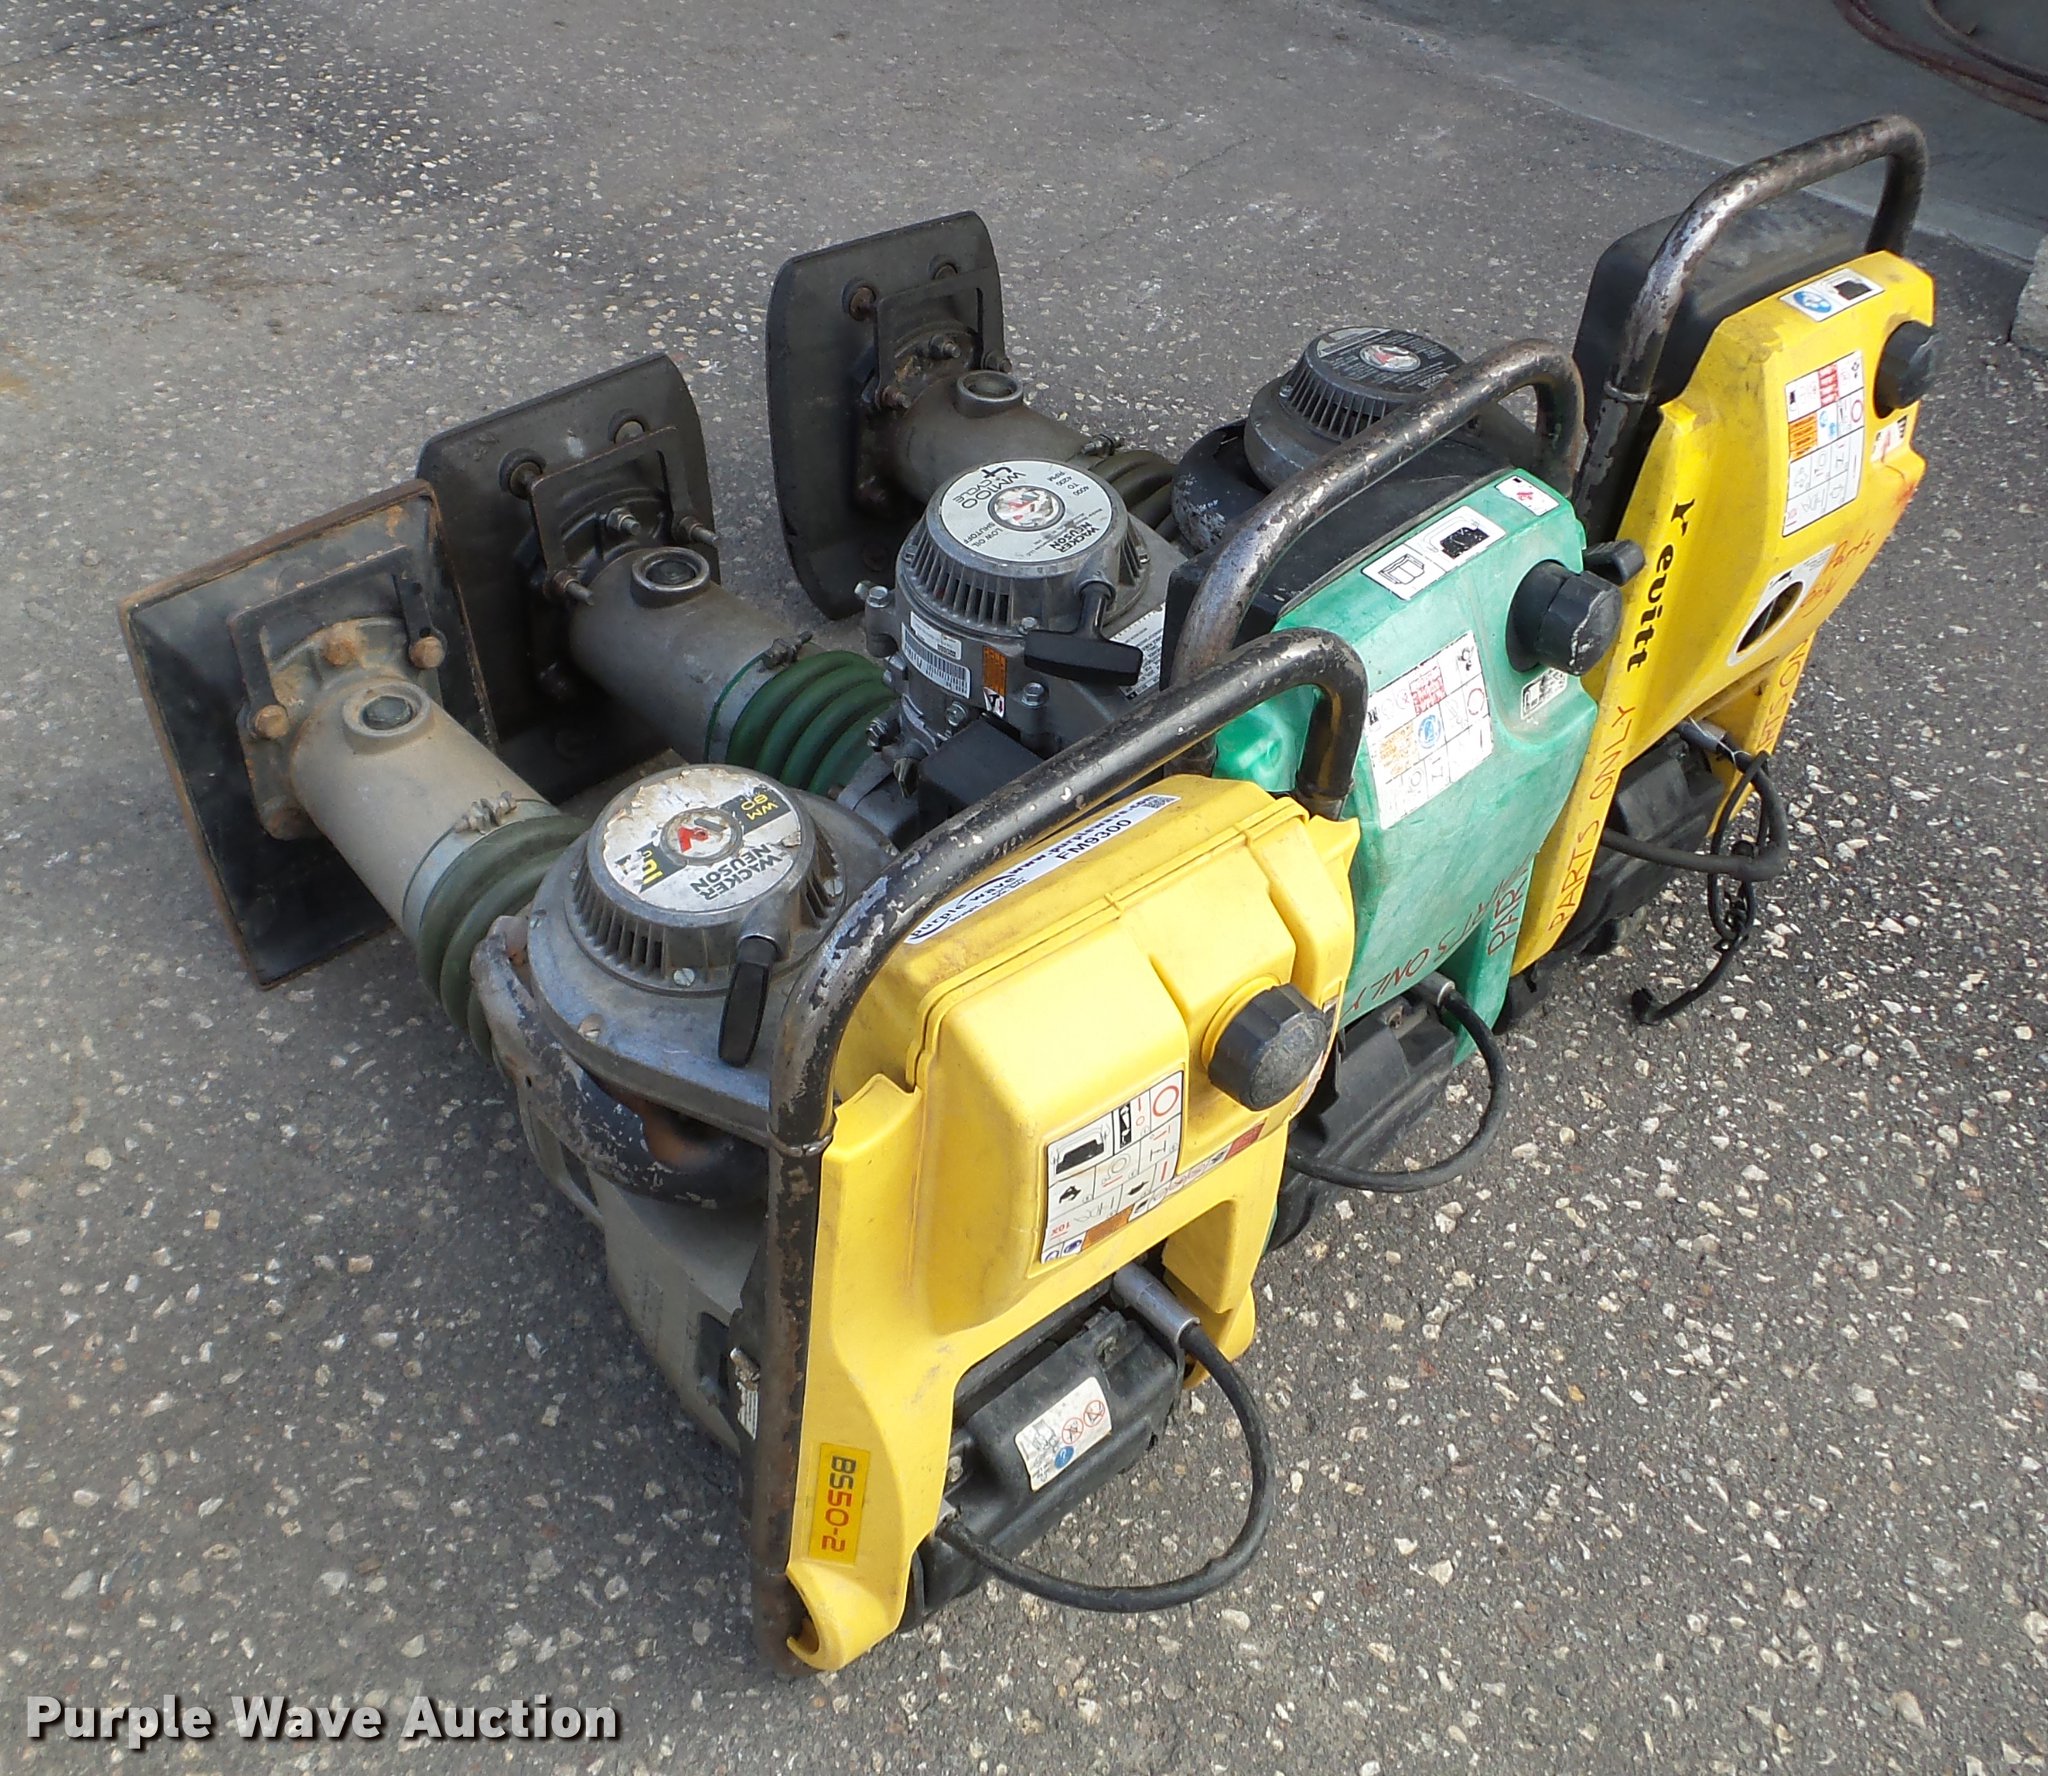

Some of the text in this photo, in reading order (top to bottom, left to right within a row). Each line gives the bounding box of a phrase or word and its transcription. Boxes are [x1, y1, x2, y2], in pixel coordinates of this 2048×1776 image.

[961, 471, 1026, 509] WM100
[963, 522, 996, 545] SHUTOFF
[1049, 522, 1093, 549] NEUSON
[1056, 526, 1101, 553] WACKER
[746, 801, 779, 820] WM
[1549, 705, 1636, 931] PARTS ONLY
[1055, 818, 1132, 861] FM9300
[689, 843, 772, 893] NEUSON
[699, 854, 783, 901] WACKER
[910, 902, 966, 938] purple
[969, 875, 1017, 902] wave
[821, 1455, 857, 1553] BS50-2
